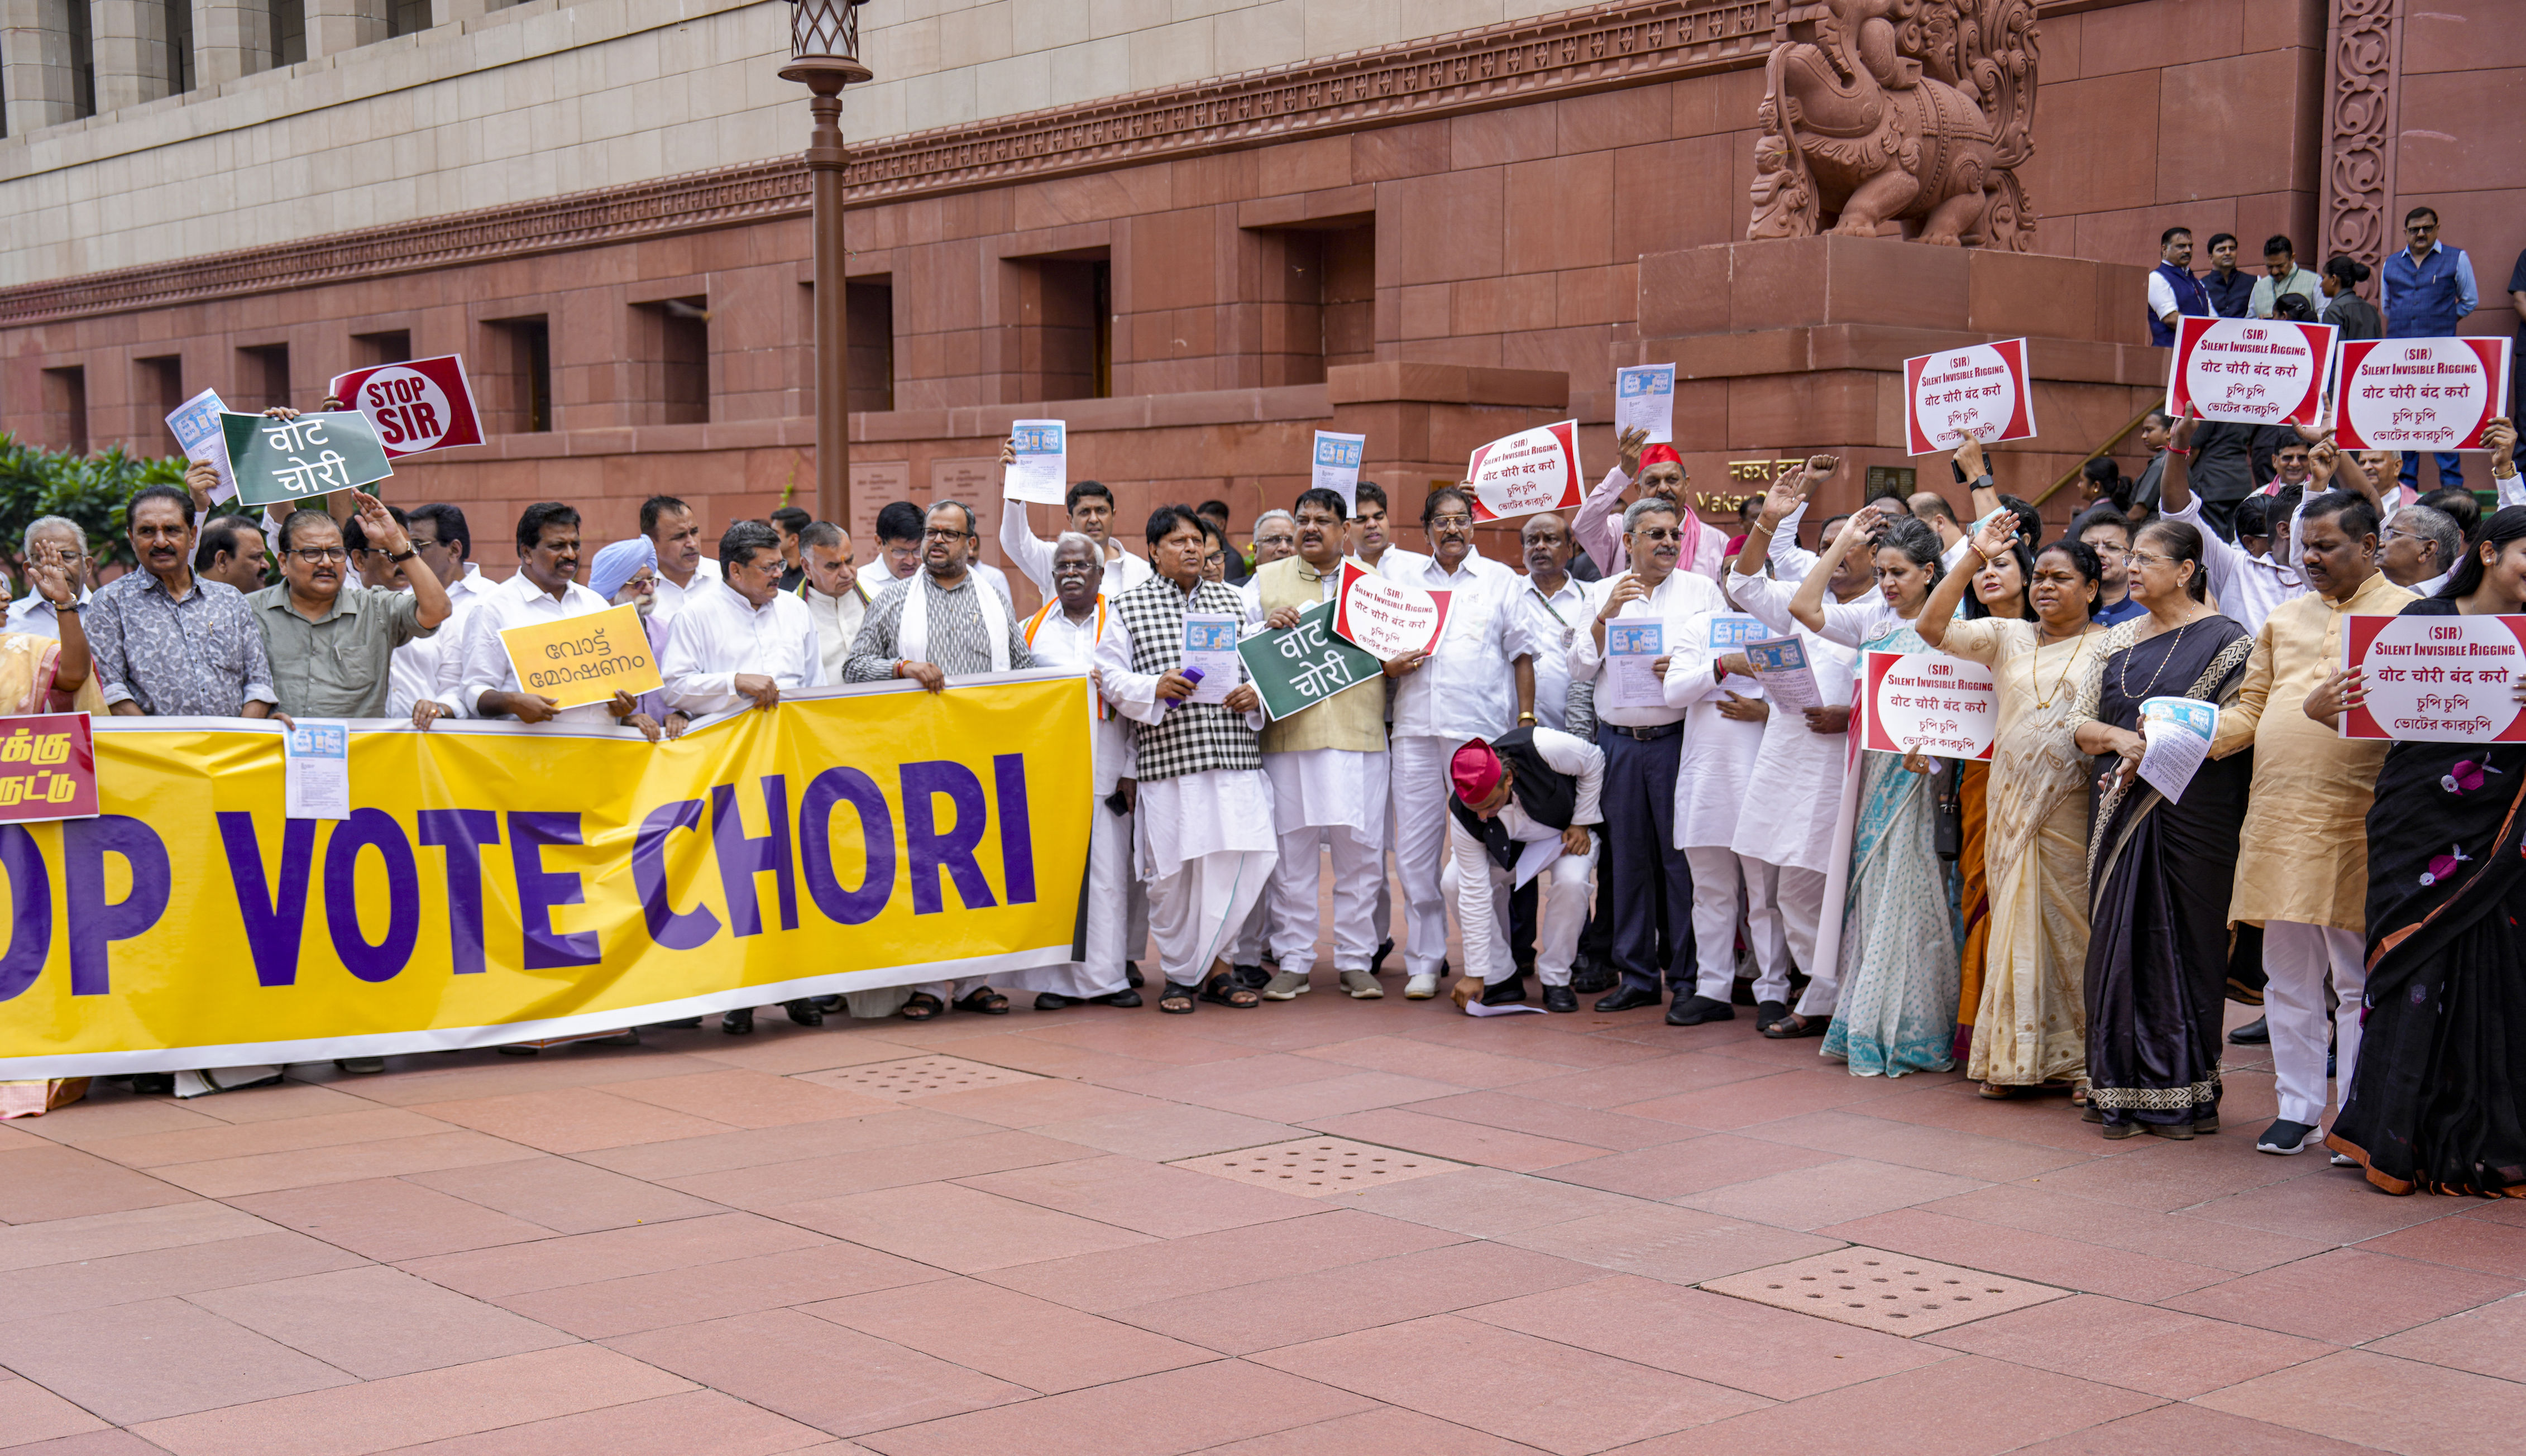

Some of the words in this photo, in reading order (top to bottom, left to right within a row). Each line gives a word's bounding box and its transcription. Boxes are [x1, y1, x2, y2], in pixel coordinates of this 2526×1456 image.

[2243, 328, 2267, 341] (SIR)
[2201, 339, 2228, 351] SILENT
[2230, 341, 2269, 353] INVISIBLE
[2270, 344, 2306, 356] RIGGING
[2405, 348, 2432, 361] (SIR)
[1950, 355, 1970, 370] (SIR)
[2201, 359, 2222, 372] वोट
[2226, 361, 2251, 375] चोरी
[2254, 362, 2271, 377] बंद
[2275, 364, 2298, 377] करो
[2362, 364, 2390, 376] SILENT
[2393, 363, 2435, 375] INVISIBLE
[2437, 363, 2477, 373] RIGGING
[1922, 376, 1941, 387] SILENT
[1943, 370, 1973, 383] INVISIBLE
[1974, 365, 2004, 377] RIGGING
[366, 377, 425, 408] STOP
[1925, 394, 1940, 406] वोट
[1943, 389, 1962, 404] चोरी
[1965, 387, 1979, 400] बंद
[1982, 382, 2001, 396] करो
[2227, 383, 2245, 398] চুপি
[2247, 385, 2266, 399] চুপি
[2363, 385, 2385, 399] वोट
[2389, 384, 2416, 399] चोरी
[2420, 383, 2441, 399] बंद
[2445, 383, 2470, 397] करो
[1948, 410, 1962, 427] চুপি
[1963, 408, 1978, 424] চুপি
[2208, 400, 2241, 413] ভোটের
[2243, 402, 2279, 418] কারচুপি
[2393, 408, 2413, 425] চুপি
[2415, 408, 2436, 424] চুপি
[376, 402, 443, 444] SIR
[262, 416, 328, 453] वोट
[1511, 438, 1527, 449] (SIR)
[2374, 428, 2409, 440] ভোটের
[2413, 427, 2455, 443] কারচুপি
[271, 449, 350, 494] चोरी
[1484, 471, 1497, 481] वोट
[1501, 466, 1518, 477] चोरी
[1523, 463, 1535, 473] बंद
[1539, 459, 1554, 470] करो
[1728, 459, 1771, 481] मकर
[1384, 587, 1403, 600] (SIR)
[1355, 600, 1368, 613] वोट
[1371, 608, 1389, 622] चोरी
[1391, 616, 1405, 628] बंद
[1408, 619, 1426, 629] करो
[2429, 626, 2462, 640] (SIR)
[546, 628, 611, 659] വോട്ട്
[2375, 642, 2412, 655] SILENT
[2414, 643, 2466, 656] INVISIBLE
[2469, 643, 2515, 656] RIGGING
[529, 655, 645, 688] മോഷണം
[1289, 649, 1353, 697] चोरी
[1928, 664, 1953, 677] (SIR)
[2379, 665, 2407, 682] वोट
[2412, 667, 2444, 683] चोरी
[2450, 667, 2474, 684] बंद
[2479, 666, 2509, 683] करो
[1888, 674, 1915, 687] SILENT
[1917, 677, 1956, 689] INVISIBLE
[1958, 679, 1993, 692] RIGGING
[1891, 694, 1911, 707] वोट
[1915, 696, 1940, 710] चोरी
[1943, 698, 1961, 712] बंद
[1964, 700, 1987, 713] करो
[2417, 694, 2442, 712] চুপি
[2444, 694, 2469, 712] চুপি
[1919, 718, 1938, 732] চুপি
[1940, 720, 1958, 734] চুপি
[2394, 715, 2439, 730] ভোটের
[2441, 716, 2492, 734] কারচুপি
[1939, 737, 1975, 752] কারচুপি
[216, 807, 601, 987] VOTE
[631, 753, 1037, 950] CHORI
